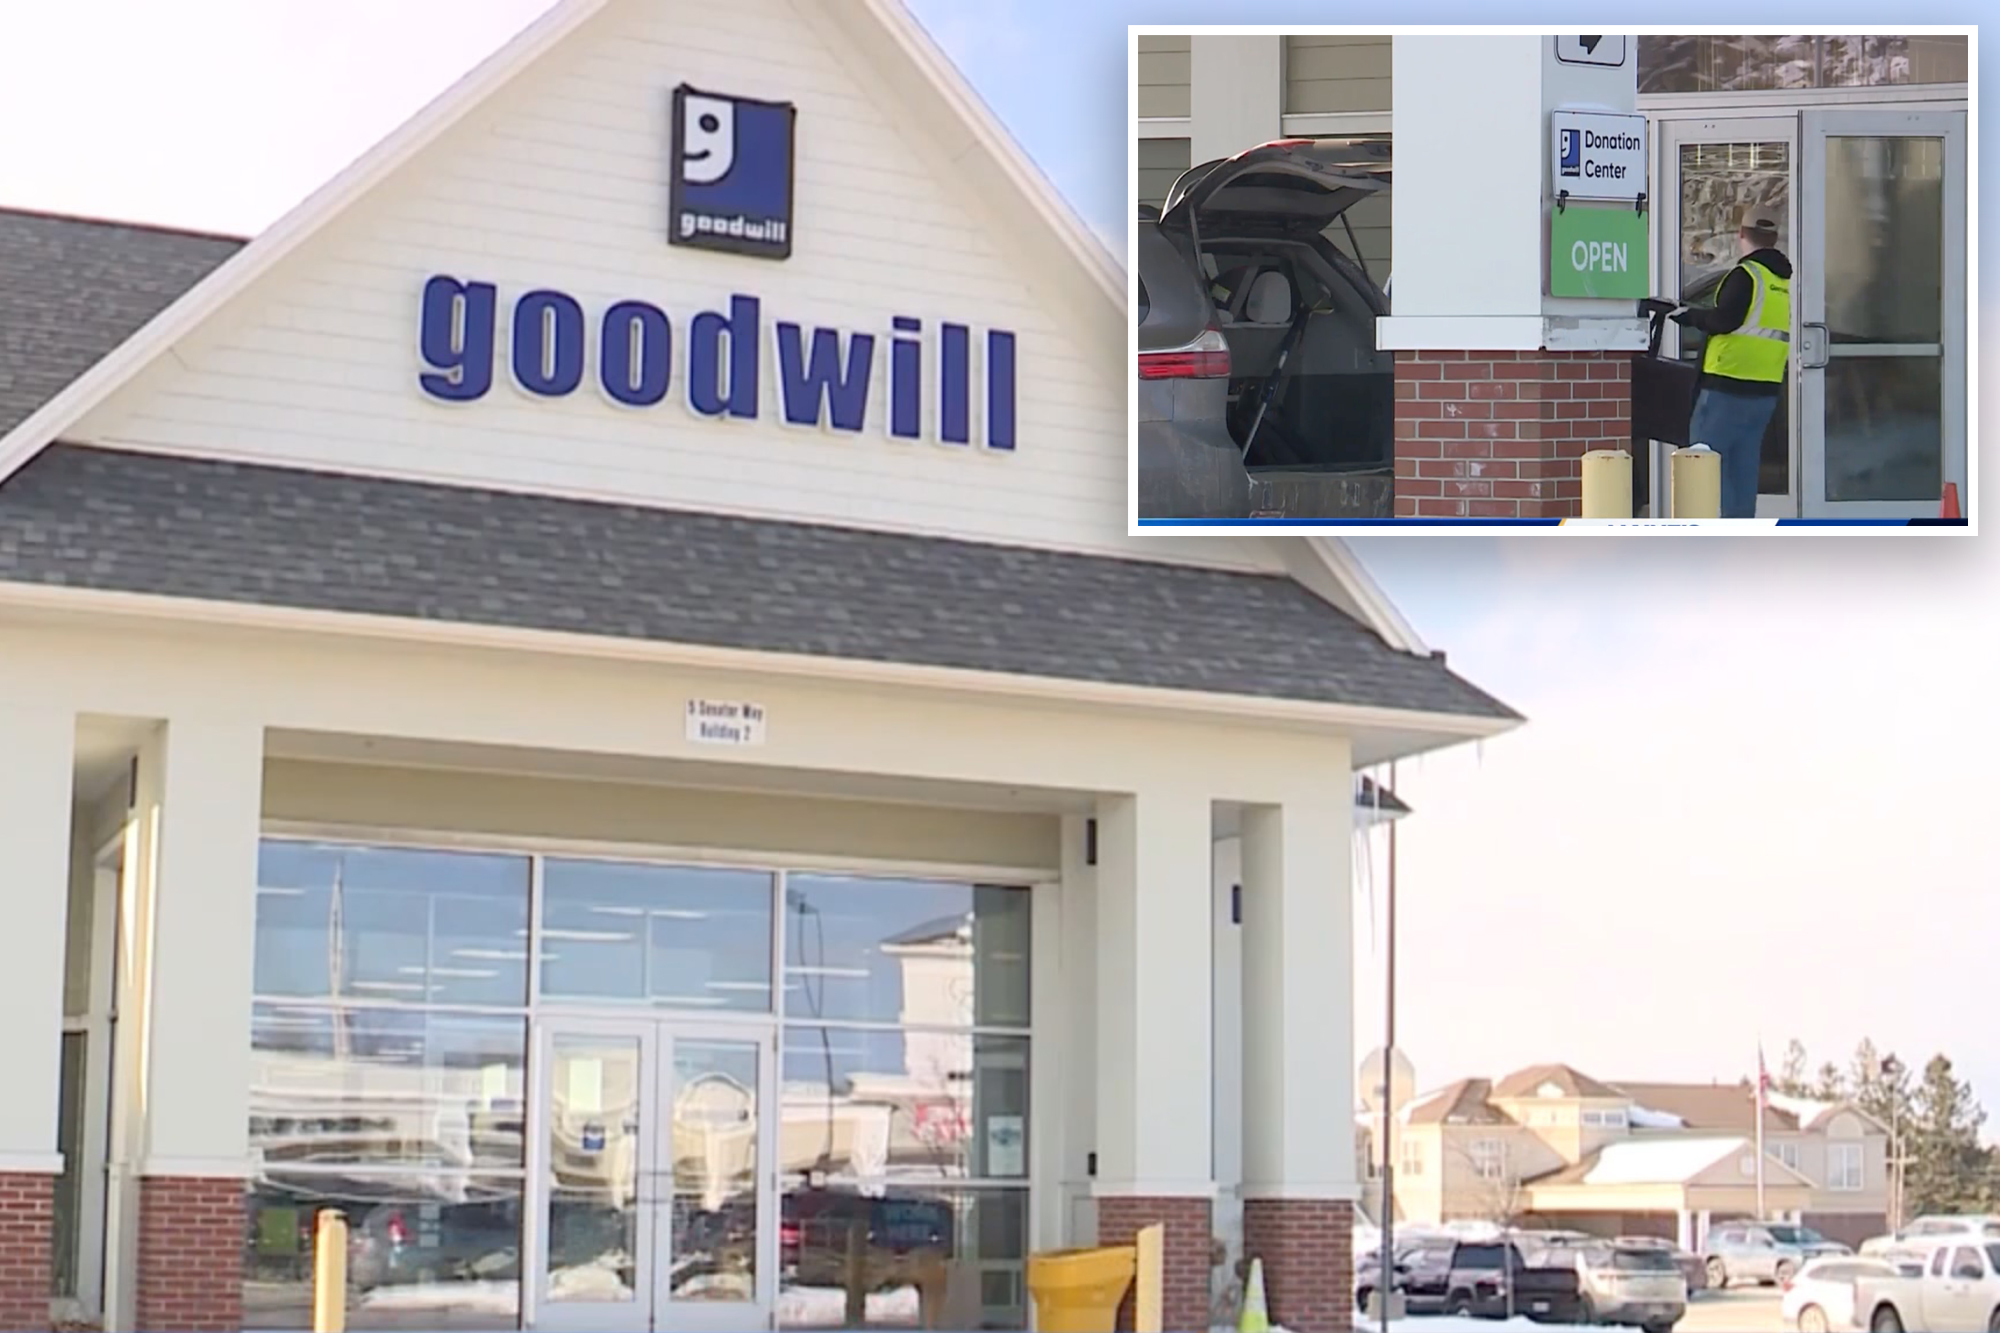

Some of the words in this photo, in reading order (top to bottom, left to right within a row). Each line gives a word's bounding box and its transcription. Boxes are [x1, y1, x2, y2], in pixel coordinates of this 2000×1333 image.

[1585, 130, 1640, 150] Donation
[1585, 159, 1626, 179] Center
[680, 213, 786, 243] goodwill
[1571, 240, 1627, 272] OPEN
[419, 274, 1017, 452] goodwill
[743, 704, 763, 722] Way
[700, 722, 740, 742] Building
